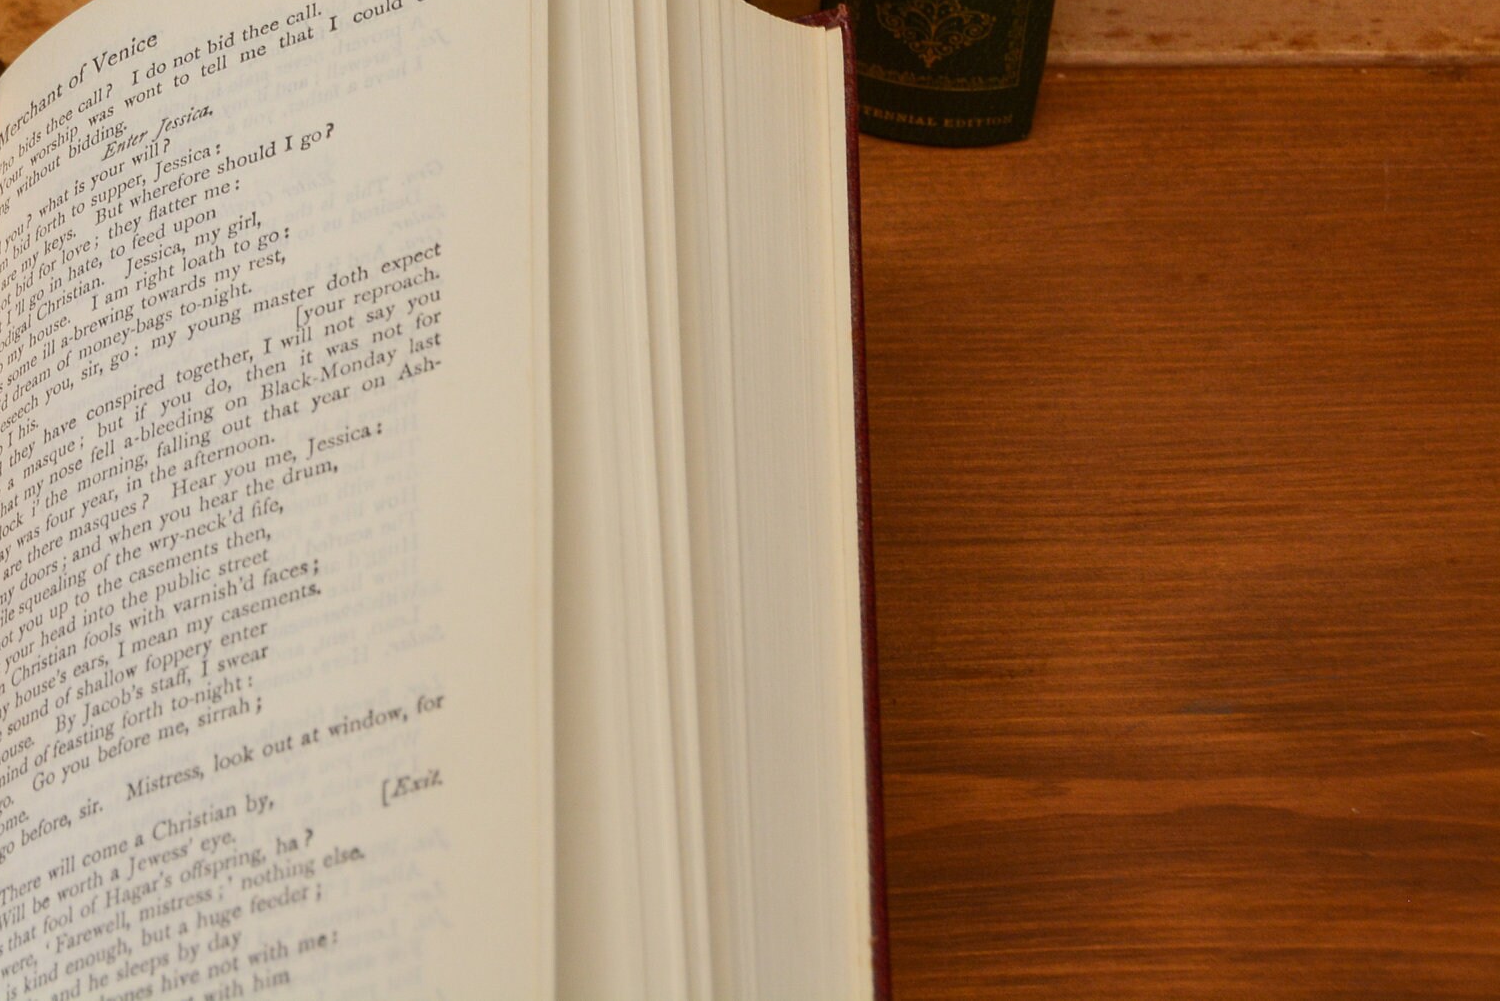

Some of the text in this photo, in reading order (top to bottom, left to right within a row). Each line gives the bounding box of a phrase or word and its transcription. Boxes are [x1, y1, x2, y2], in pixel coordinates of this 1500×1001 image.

[29, 124, 79, 166] worship
[88, 106, 114, 127] was
[124, 82, 162, 108] wont
[173, 73, 190, 88] to
[201, 54, 227, 78] tell
[240, 45, 267, 63] me
[279, 26, 314, 49] that
[329, 15, 338, 32] I
[68, 62, 88, 89] of
[92, 34, 158, 73] Venice
[101, 105, 214, 162] Enter Jessica.
[858, 104, 937, 127] TENNIAL
[95, 122, 335, 226] But wherefore should I go?
[45, 242, 441, 406] you, sir, go: my young master doth expect
[296, 266, 440, 329] [your reproach.
[171, 422, 383, 499] Hear you me, Jessica:
[126, 695, 445, 802] Mistress, look out at window, for
[48, 854, 75, 881] will
[81, 840, 128, 868] come
[134, 834, 145, 848] a
[151, 805, 237, 841] Christian
[245, 793, 275, 815] by,
